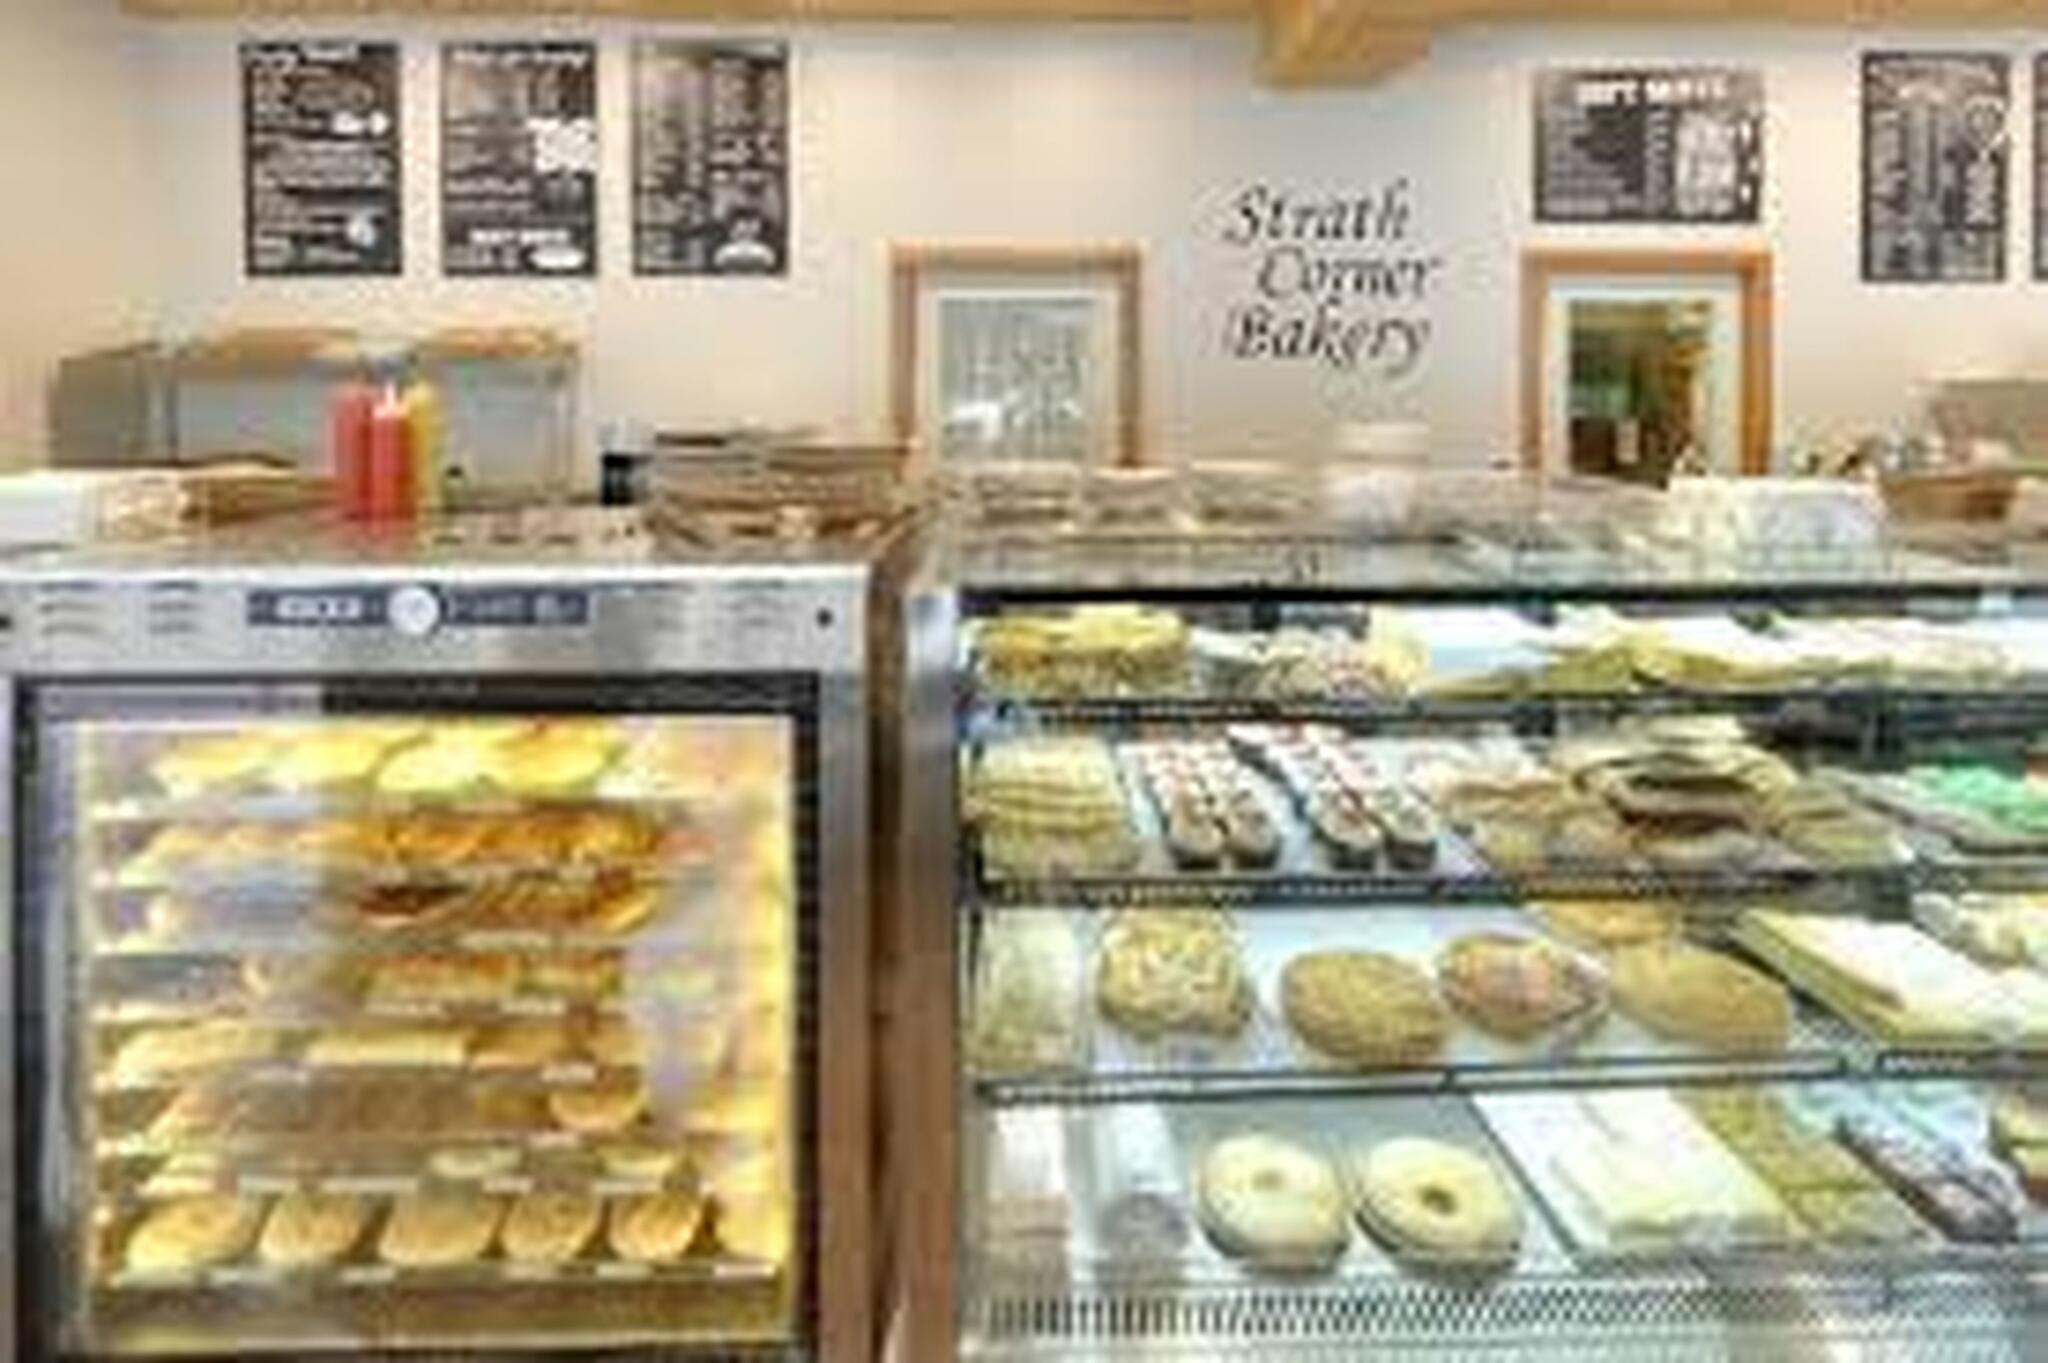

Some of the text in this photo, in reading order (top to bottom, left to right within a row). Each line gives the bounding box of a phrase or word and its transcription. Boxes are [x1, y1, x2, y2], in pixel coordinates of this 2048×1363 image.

[1223, 179, 1410, 246] Strath
[1256, 247, 1442, 298] Corner
[1226, 299, 1432, 378] Bakery
